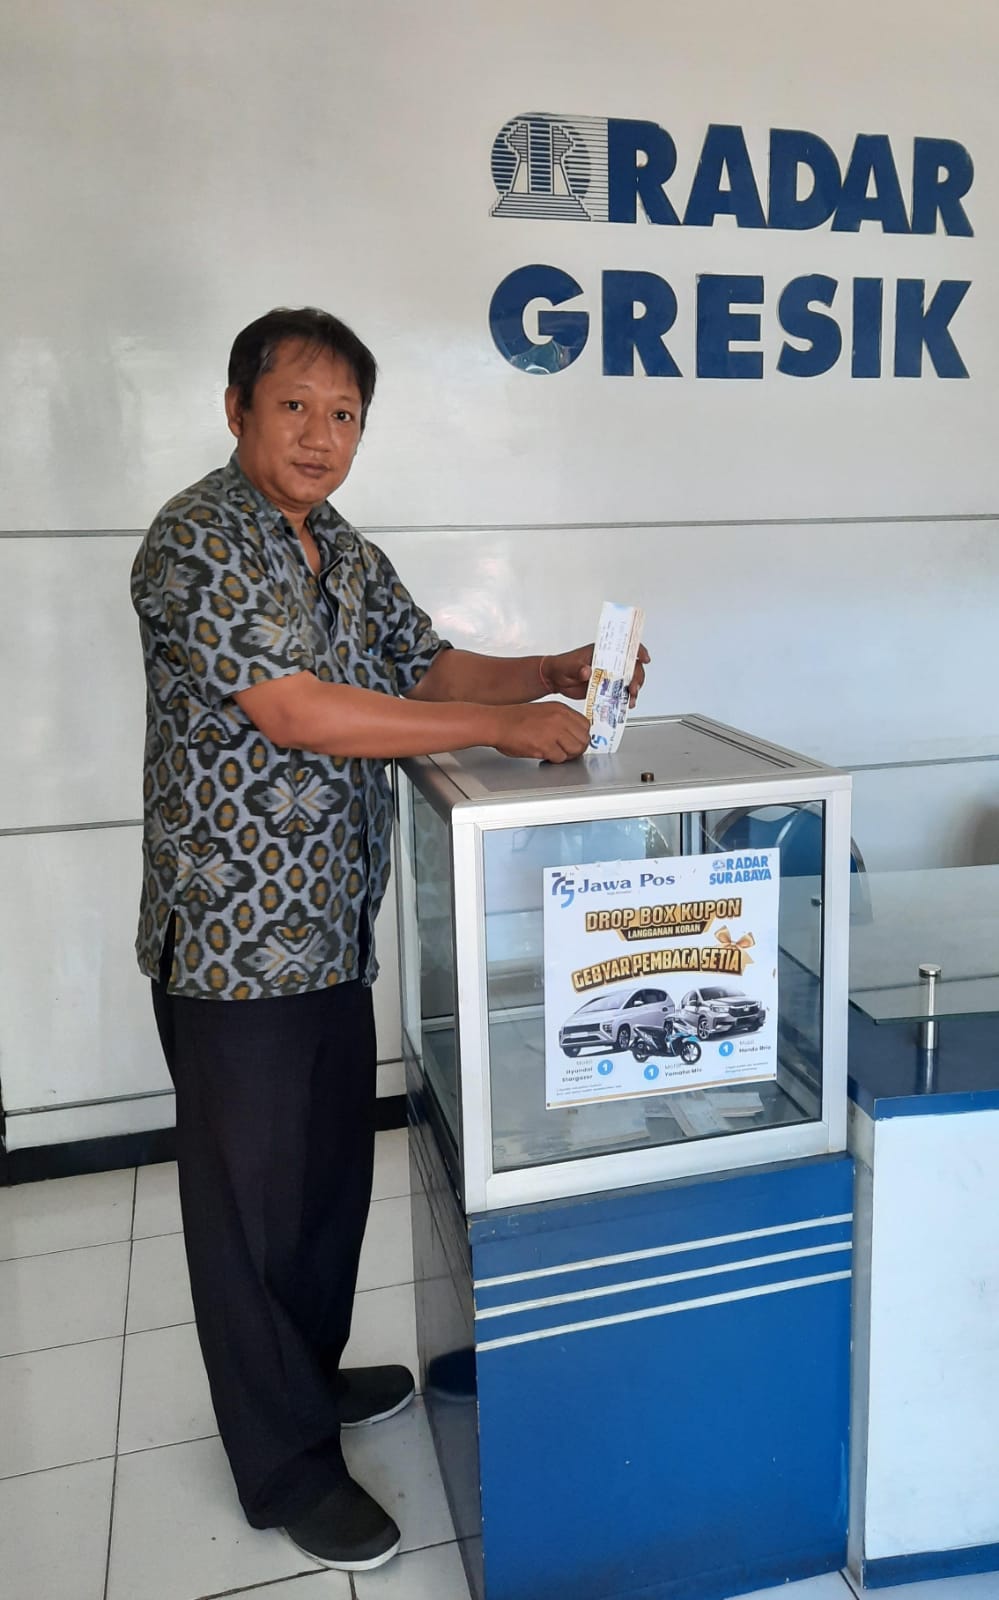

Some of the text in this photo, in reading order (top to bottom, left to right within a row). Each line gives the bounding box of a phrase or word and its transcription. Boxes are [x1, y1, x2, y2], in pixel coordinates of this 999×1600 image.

[607, 117, 975, 237] RADAR
[488, 263, 972, 380] GRESIK
[709, 868, 772, 885] SURABAYA
[726, 855, 769, 870] RADAR
[551, 872, 575, 908] 75
[577, 879, 632, 893] Jawa
[640, 873, 676, 887] Pos
[586, 898, 742, 931] DROP BOX KUPON
[628, 924, 700, 939] LANGGANAN KORAN
[572, 947, 743, 991] GEBYAR PEMBACA SETIA
